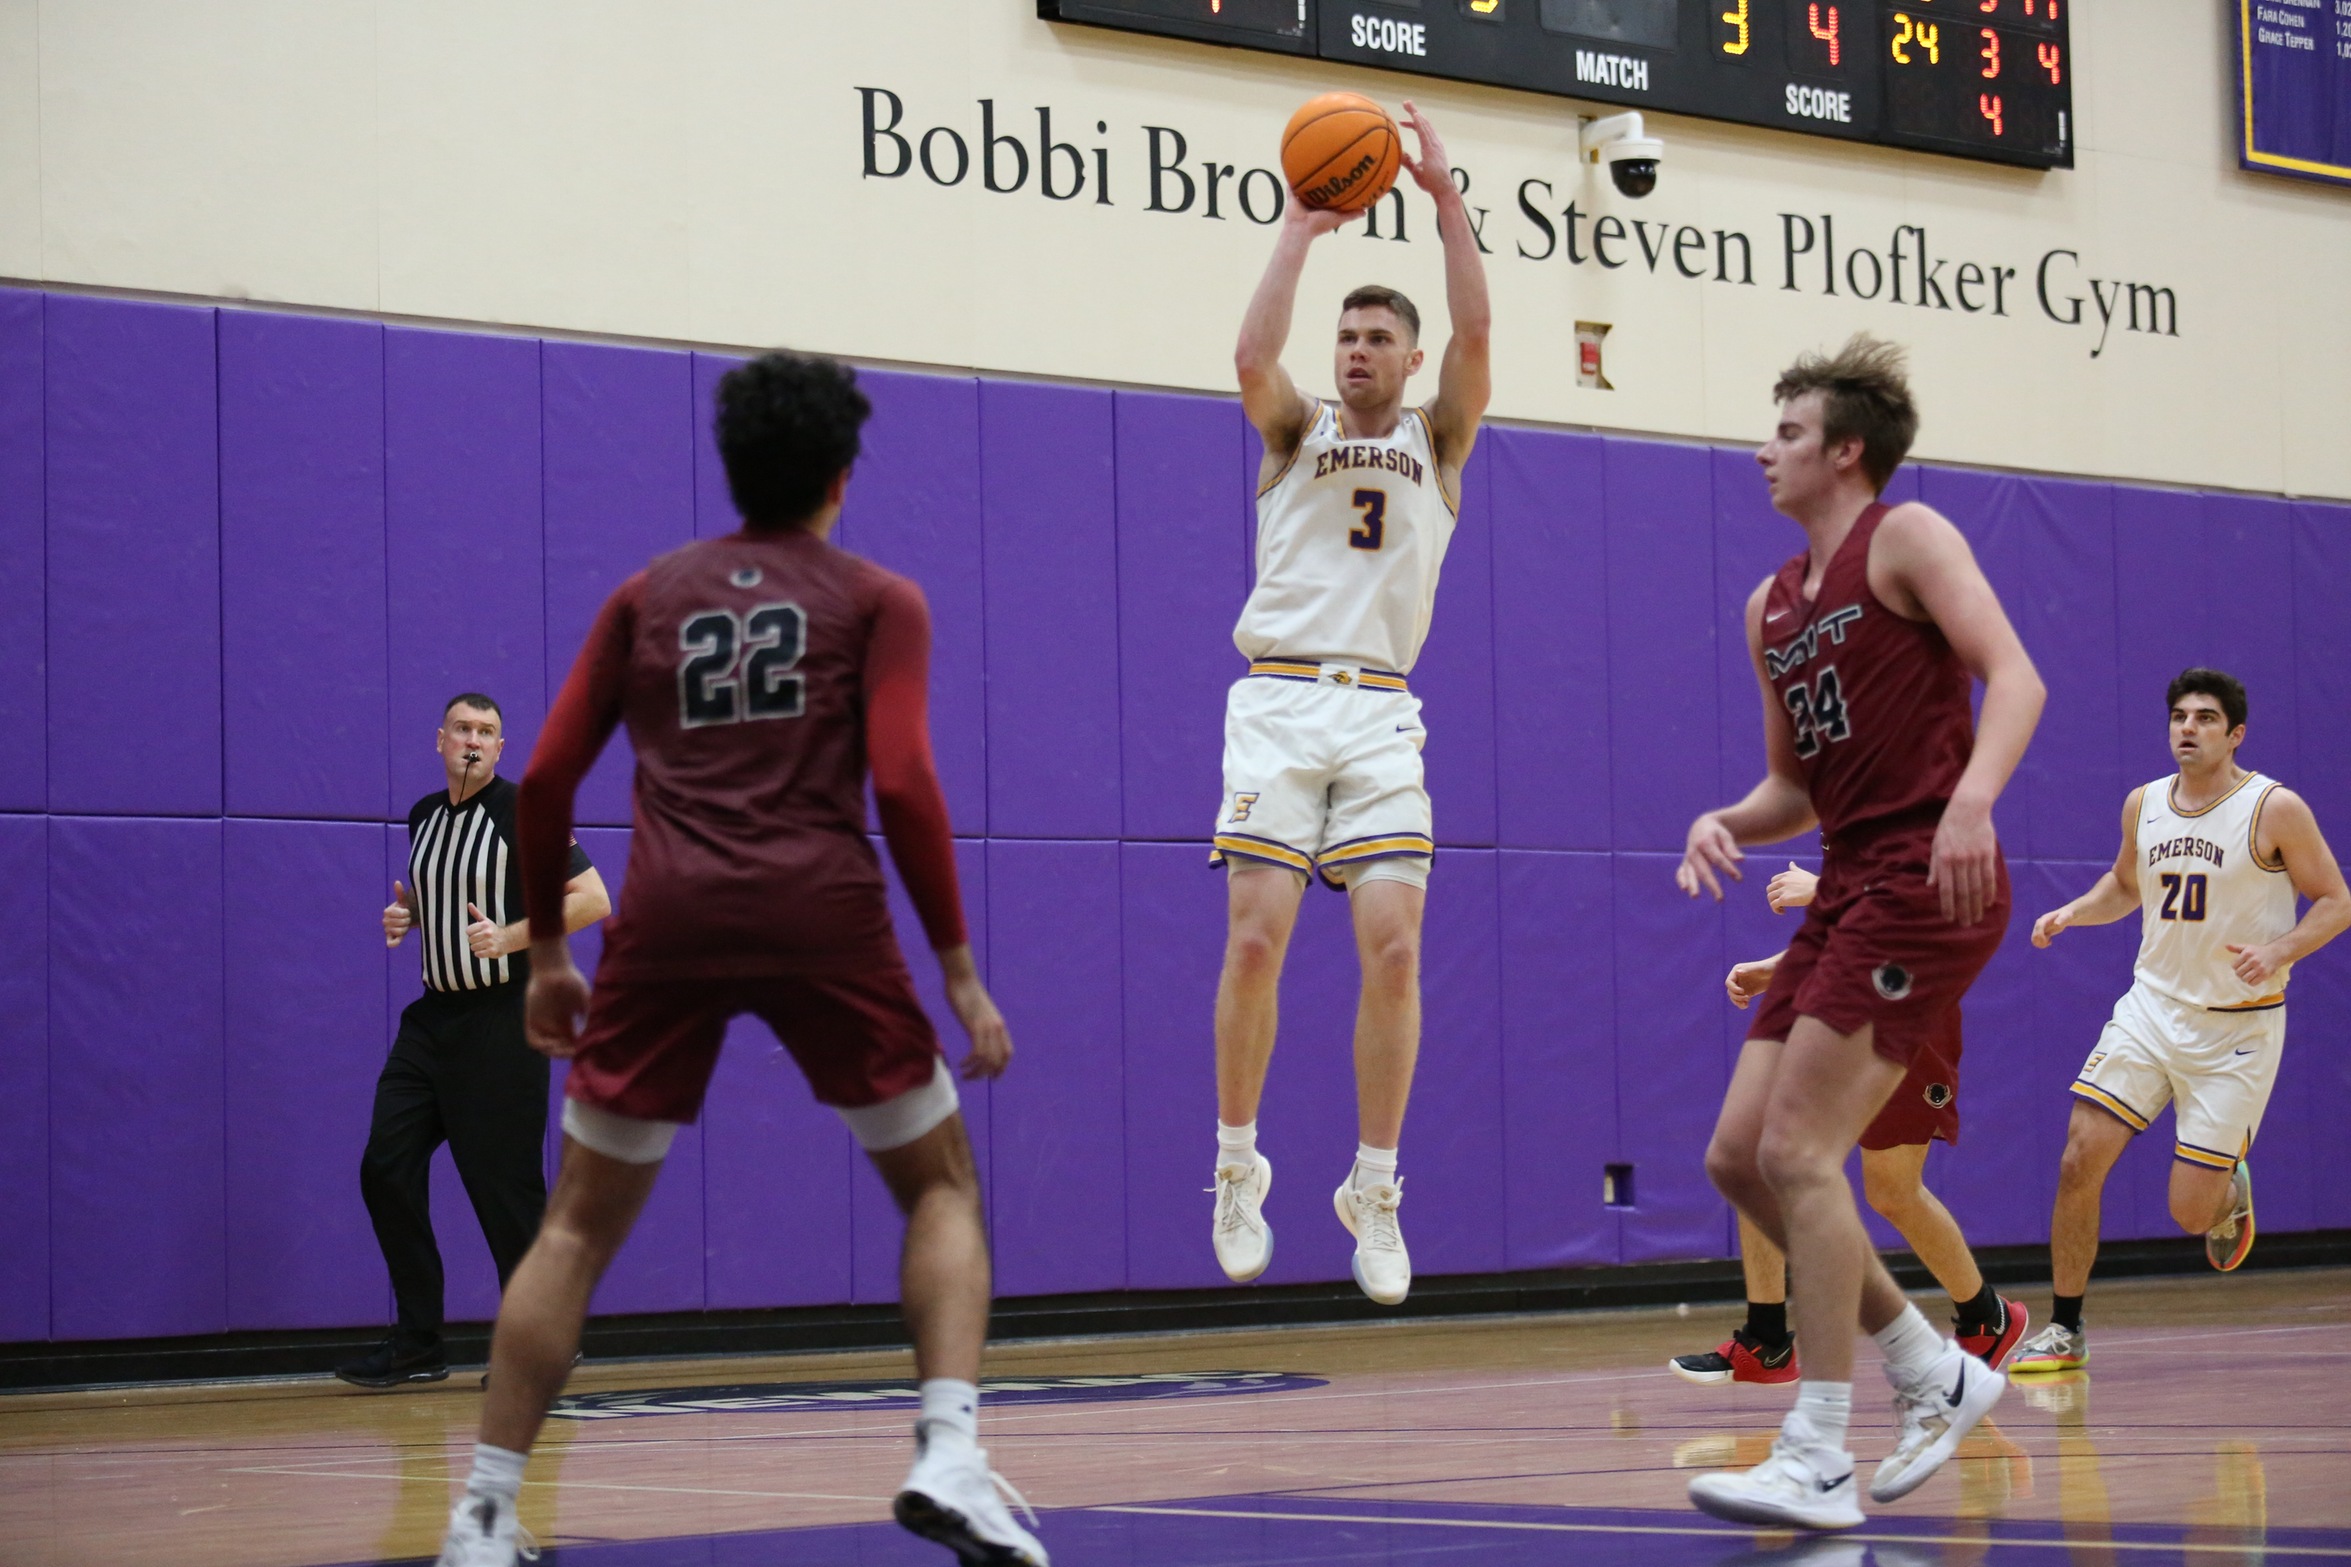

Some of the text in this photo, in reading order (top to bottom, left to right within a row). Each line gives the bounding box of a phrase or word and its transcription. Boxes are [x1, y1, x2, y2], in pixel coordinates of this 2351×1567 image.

[1351, 14, 1427, 57] SCORE
[1809, 3, 1840, 65] 4
[2257, 5, 2305, 28] FARA COHEN
[2258, 27, 2315, 51] GRACE TEPPER
[1575, 49, 1648, 91] MATCH
[1892, 13, 2061, 84] 24 3 4
[1785, 82, 1852, 123] SCORE
[1980, 93, 2003, 136] 4
[1305, 155, 1375, 205] Wilson
[853, 87, 1115, 206] Bobbi
[1142, 126, 1411, 243] Bron
[1516, 178, 1757, 286] Steven
[1777, 212, 2016, 318] Plofker
[2035, 249, 2182, 359] Gym
[1314, 446, 1424, 488] EMERSON
[1348, 488, 1388, 551] 3
[677, 600, 808, 730] 22
[1764, 604, 1863, 680] MIT
[1785, 664, 1850, 760] 24
[2149, 837, 2225, 868] EMERSON
[2160, 871, 2208, 921] 20
